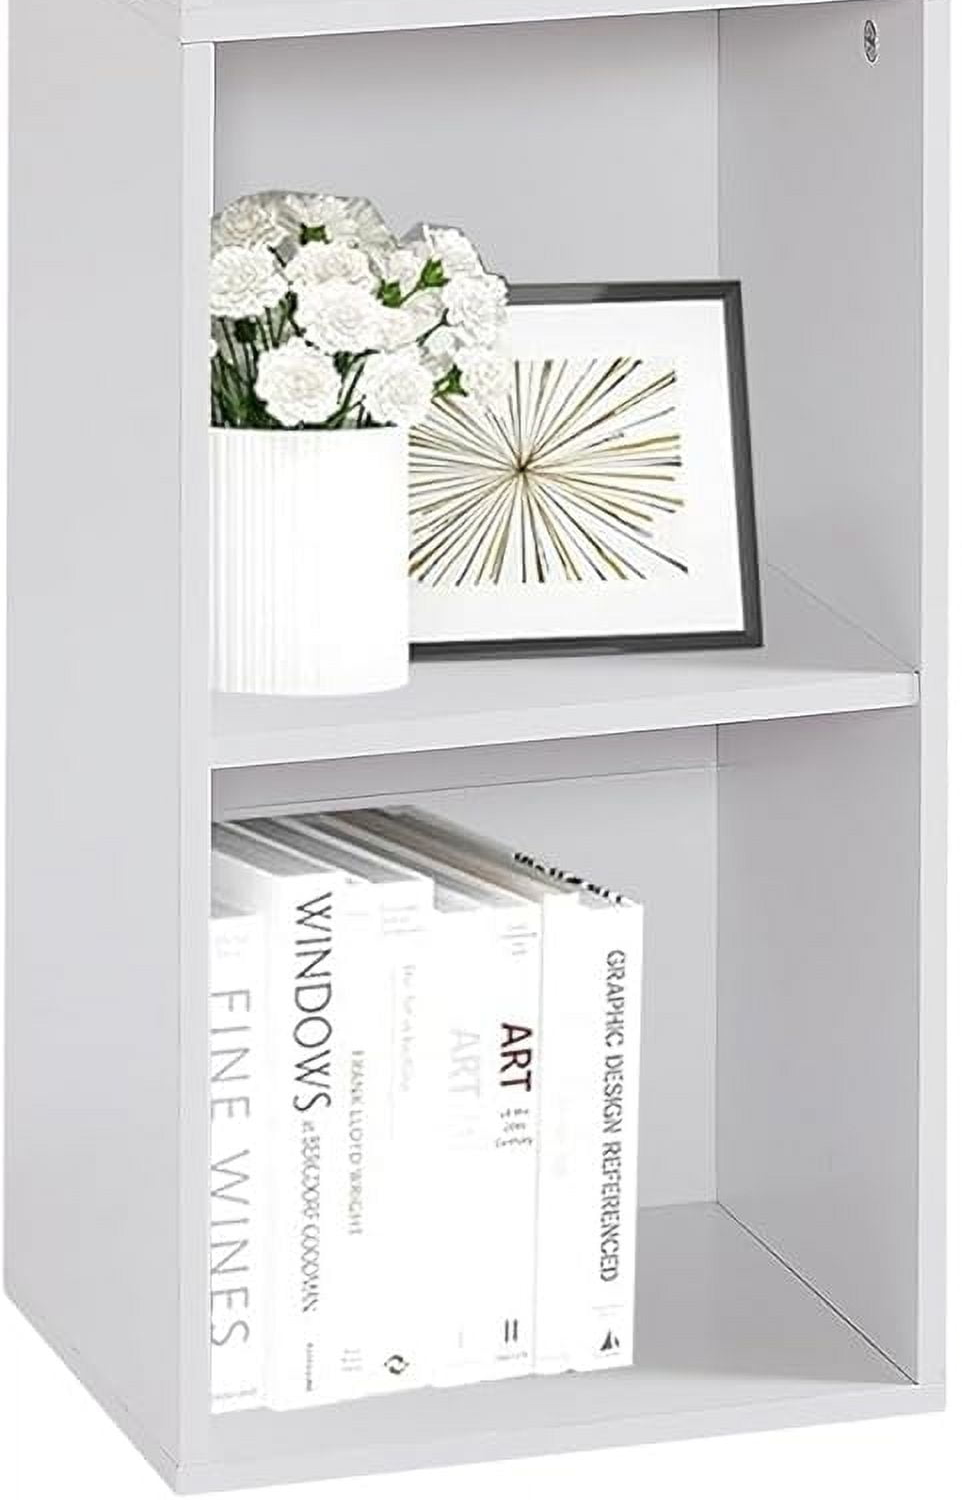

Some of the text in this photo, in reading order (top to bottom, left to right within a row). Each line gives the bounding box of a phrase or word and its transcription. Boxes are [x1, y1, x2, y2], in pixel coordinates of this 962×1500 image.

[211, 989, 250, 1117] FINE
[292, 891, 333, 1113] WINDOWS
[499, 1021, 534, 1093] ART
[599, 949, 626, 1283] GRAPHIC DESIGN REFERENCED
[211, 1149, 250, 1347] WINES
